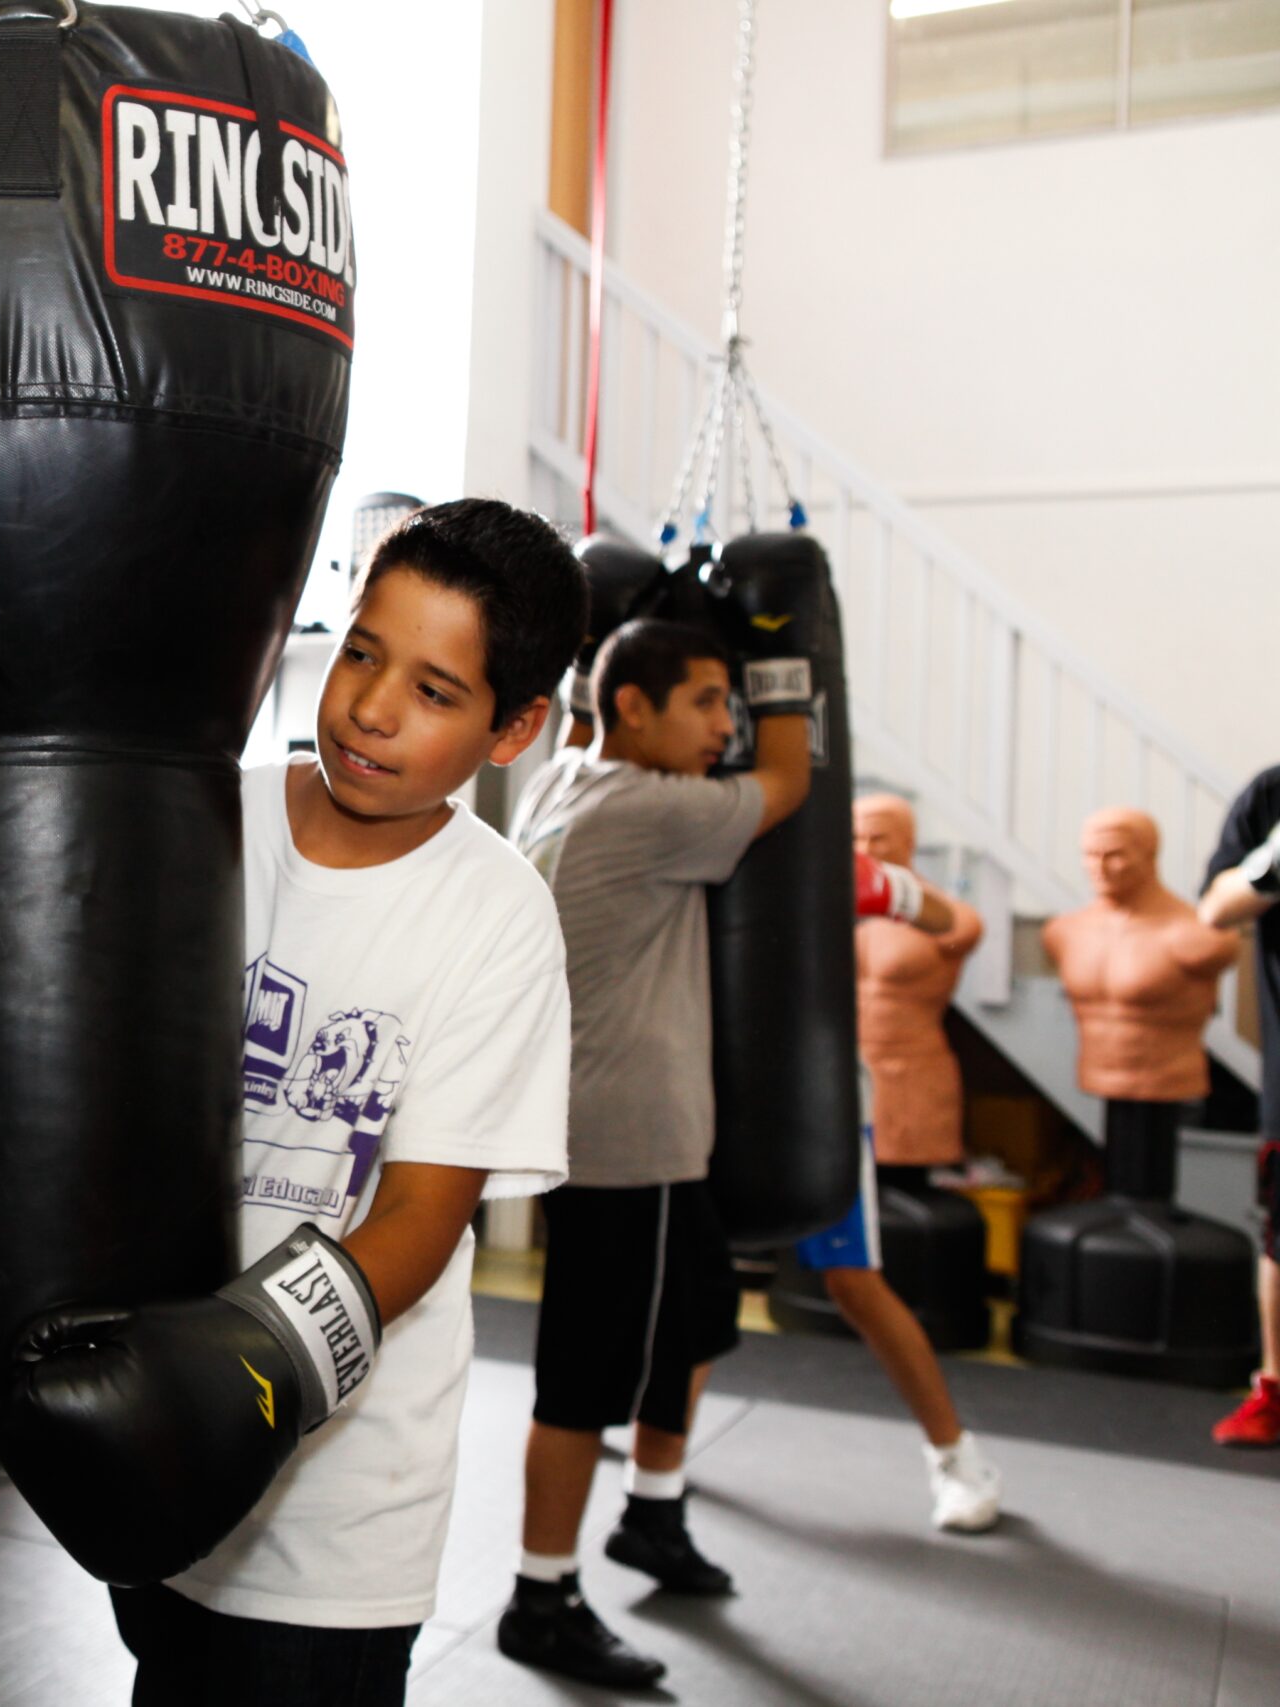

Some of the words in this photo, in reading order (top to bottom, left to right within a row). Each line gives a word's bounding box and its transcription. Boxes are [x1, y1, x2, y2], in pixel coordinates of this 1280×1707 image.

[163, 234, 345, 306] 877-4-BOXING
[186, 266, 336, 321] WWW.RINGSIDE.COM
[278, 1258, 369, 1404] EVERLAST
